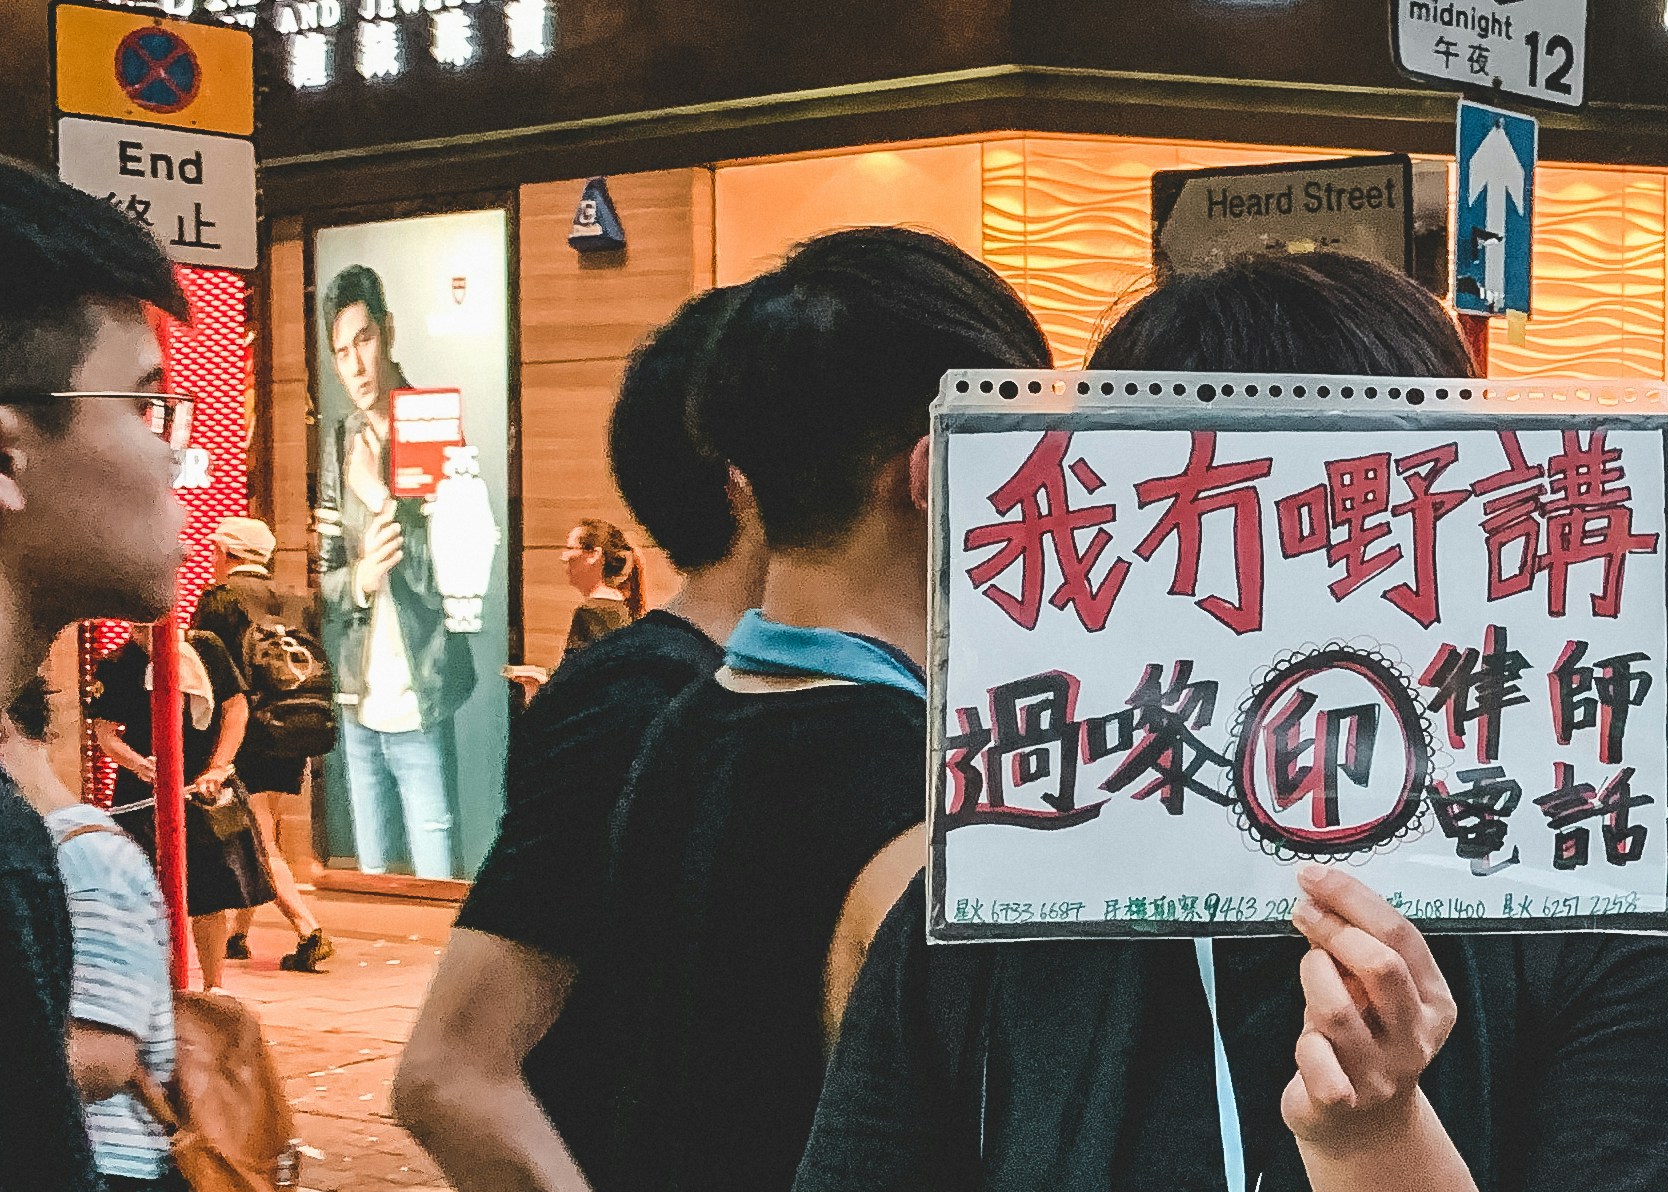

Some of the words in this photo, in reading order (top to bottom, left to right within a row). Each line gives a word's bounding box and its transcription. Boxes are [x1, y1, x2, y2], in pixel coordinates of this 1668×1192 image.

[1409, 0, 1513, 41] midnight
[1432, 35, 1491, 77] 午夜
[1524, 30, 1574, 95] 12
[118, 139, 204, 185] End
[1206, 184, 1293, 219] Heard
[1303, 177, 1398, 214] Street
[963, 430, 1660, 634] 我冇嘢講
